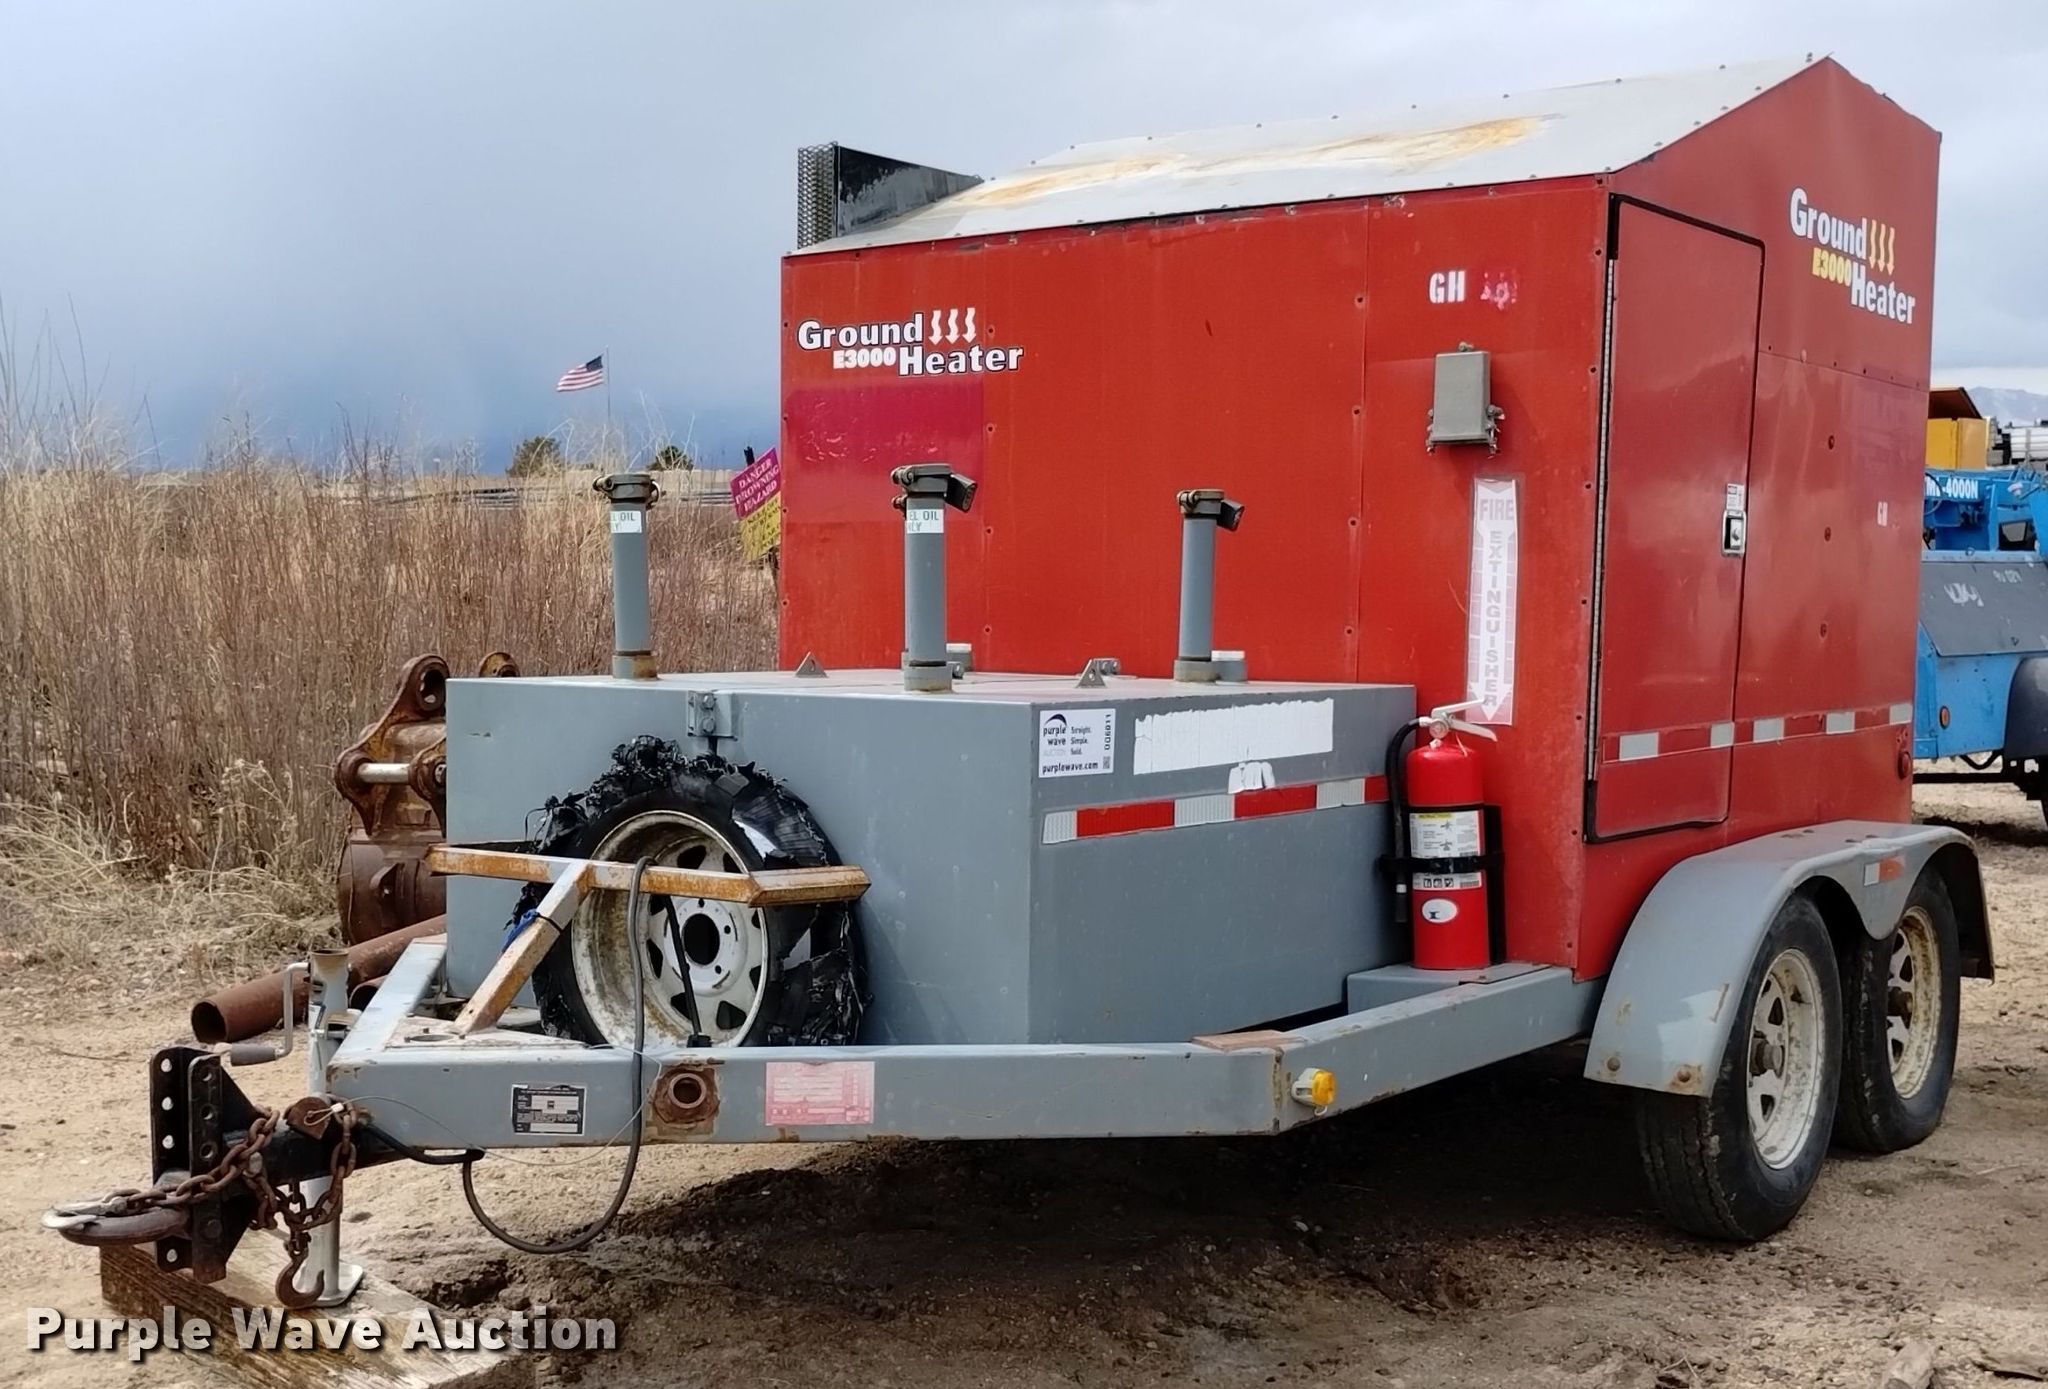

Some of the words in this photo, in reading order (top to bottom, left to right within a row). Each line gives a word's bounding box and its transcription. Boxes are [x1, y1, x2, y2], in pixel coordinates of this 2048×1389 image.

[1790, 187, 1868, 260] Ground
[1429, 271, 1466, 304] GH
[1811, 247, 1852, 287] E3000
[1851, 261, 1916, 325] Heater
[797, 312, 925, 350] Ground
[832, 346, 897, 370] E3000
[898, 343, 1024, 377] Heater
[620, 512, 636, 521] OIL
[922, 511, 939, 521] OIL
[1479, 498, 1515, 521] FIRE
[1484, 530, 1504, 707] EXTINGUISHER
[1043, 724, 1067, 737] purple
[1047, 738, 1067, 746] wave
[1042, 762, 1099, 775] purplewave.com
